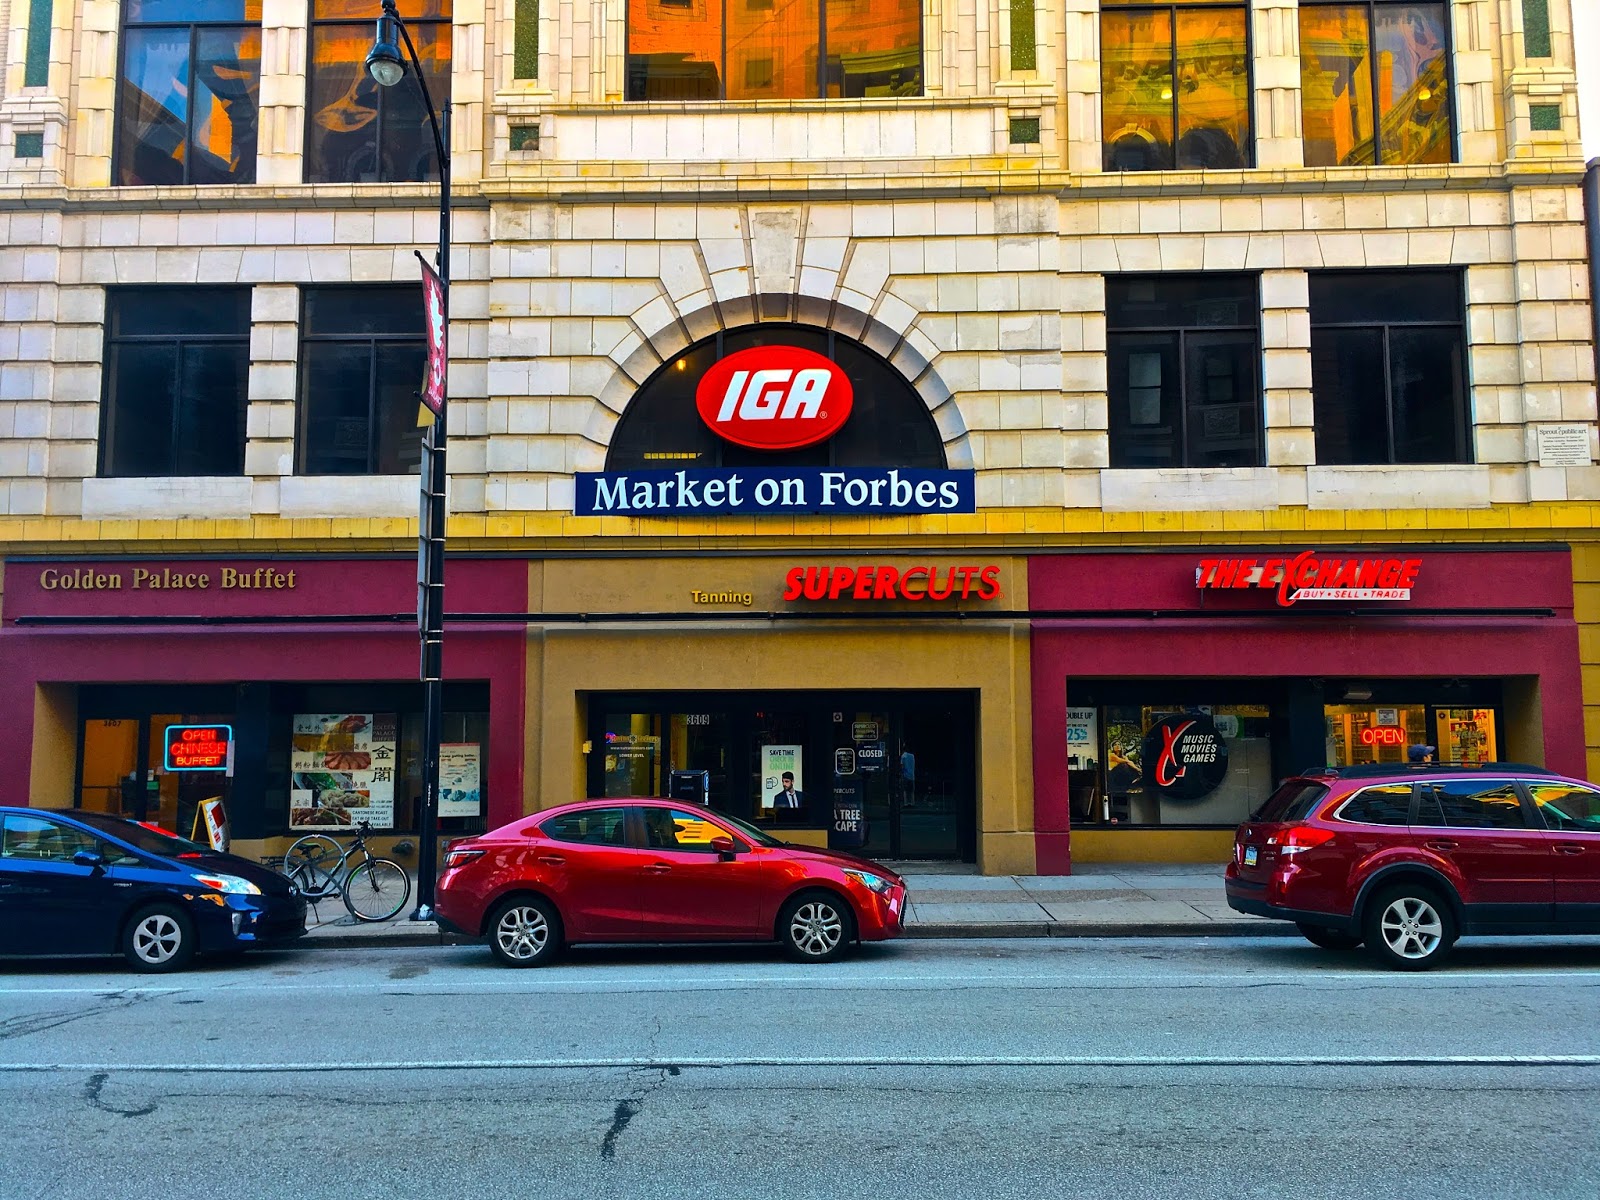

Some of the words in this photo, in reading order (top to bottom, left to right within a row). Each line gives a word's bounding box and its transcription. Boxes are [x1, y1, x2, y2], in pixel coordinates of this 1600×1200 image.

[716, 369, 832, 422] IGA
[592, 471, 744, 511] Market
[754, 478, 806, 507] on
[819, 469, 959, 509] Forbes
[40, 568, 122, 589] Golden
[131, 568, 210, 589] Palace
[220, 567, 296, 589] Buffet
[783, 565, 1001, 601] SUPERCUTS
[1196, 559, 1257, 588] THE
[1258, 550, 1422, 607] EXCHANGE
[691, 589, 752, 606] Tanning
[1303, 590, 1325, 599] BUY
[1334, 590, 1359, 599] SELL
[1370, 590, 1406, 599] TRADE
[687, 714, 709, 725] 3609
[182, 730, 216, 740] OPEN
[1182, 734, 1214, 743] MUSIC
[1362, 729, 1404, 744] OPEN
[171, 742, 226, 755] CHINESE
[1181, 744, 1217, 754] MOVIES
[858, 750, 883, 758] CLOSED
[1183, 754, 1216, 763] GAMES
[176, 756, 219, 765] BUFFET
[840, 810, 860, 820] TREE
[834, 821, 857, 831] CAPE
